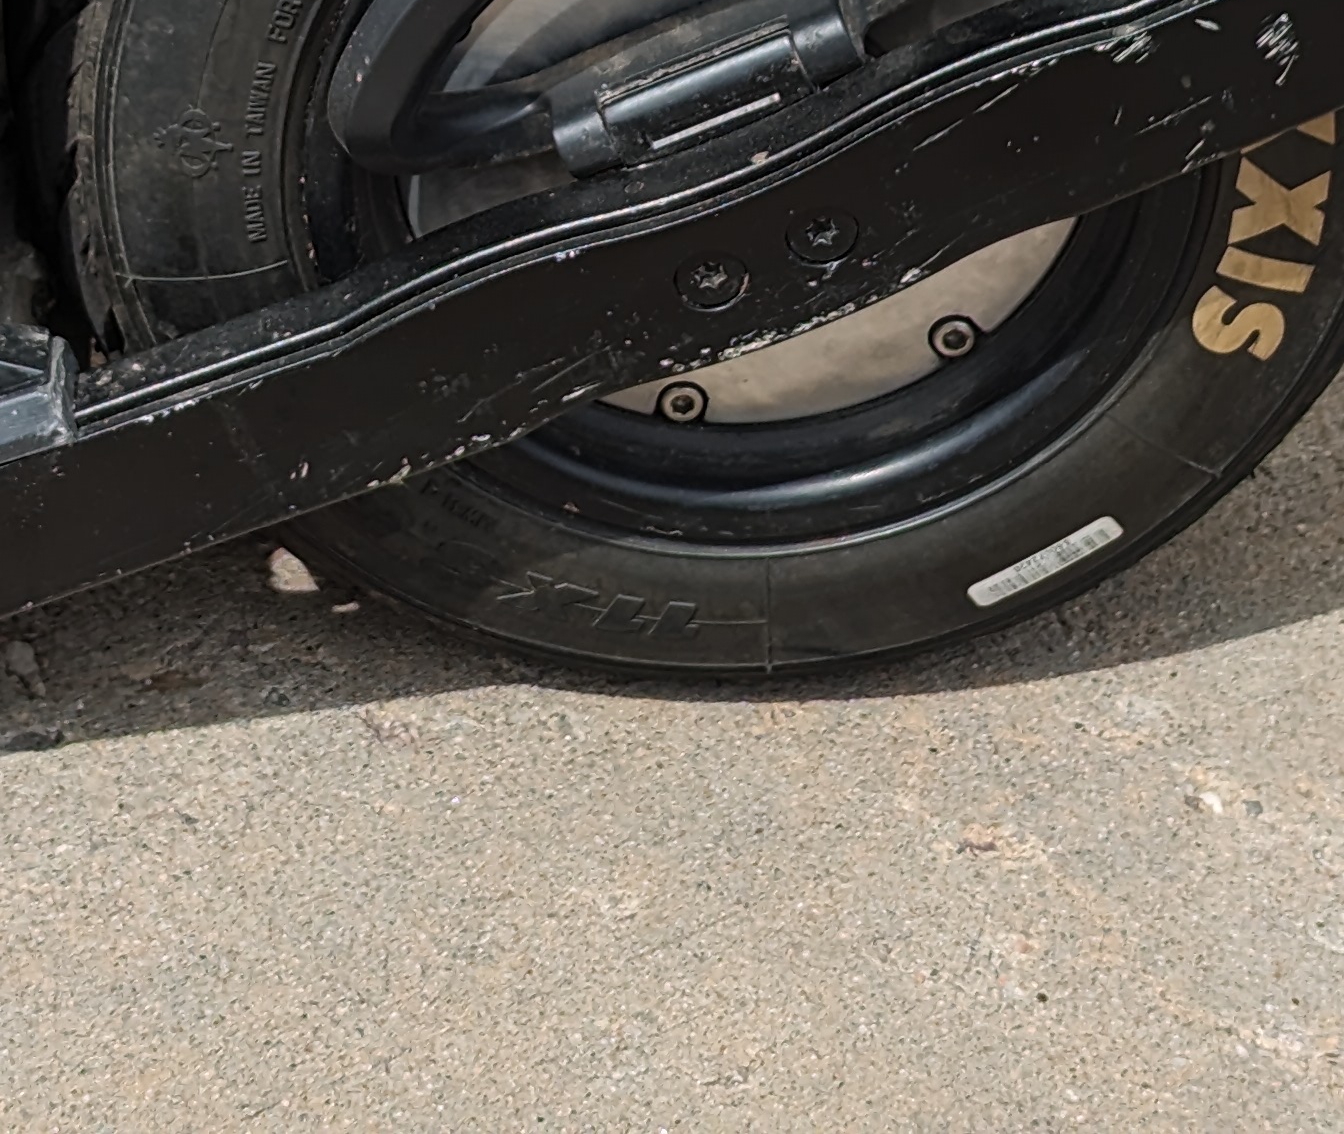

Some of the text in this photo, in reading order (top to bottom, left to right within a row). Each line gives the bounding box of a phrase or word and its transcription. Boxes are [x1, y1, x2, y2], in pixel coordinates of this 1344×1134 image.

[240, 60, 278, 243] MADE IN TAIWAN
